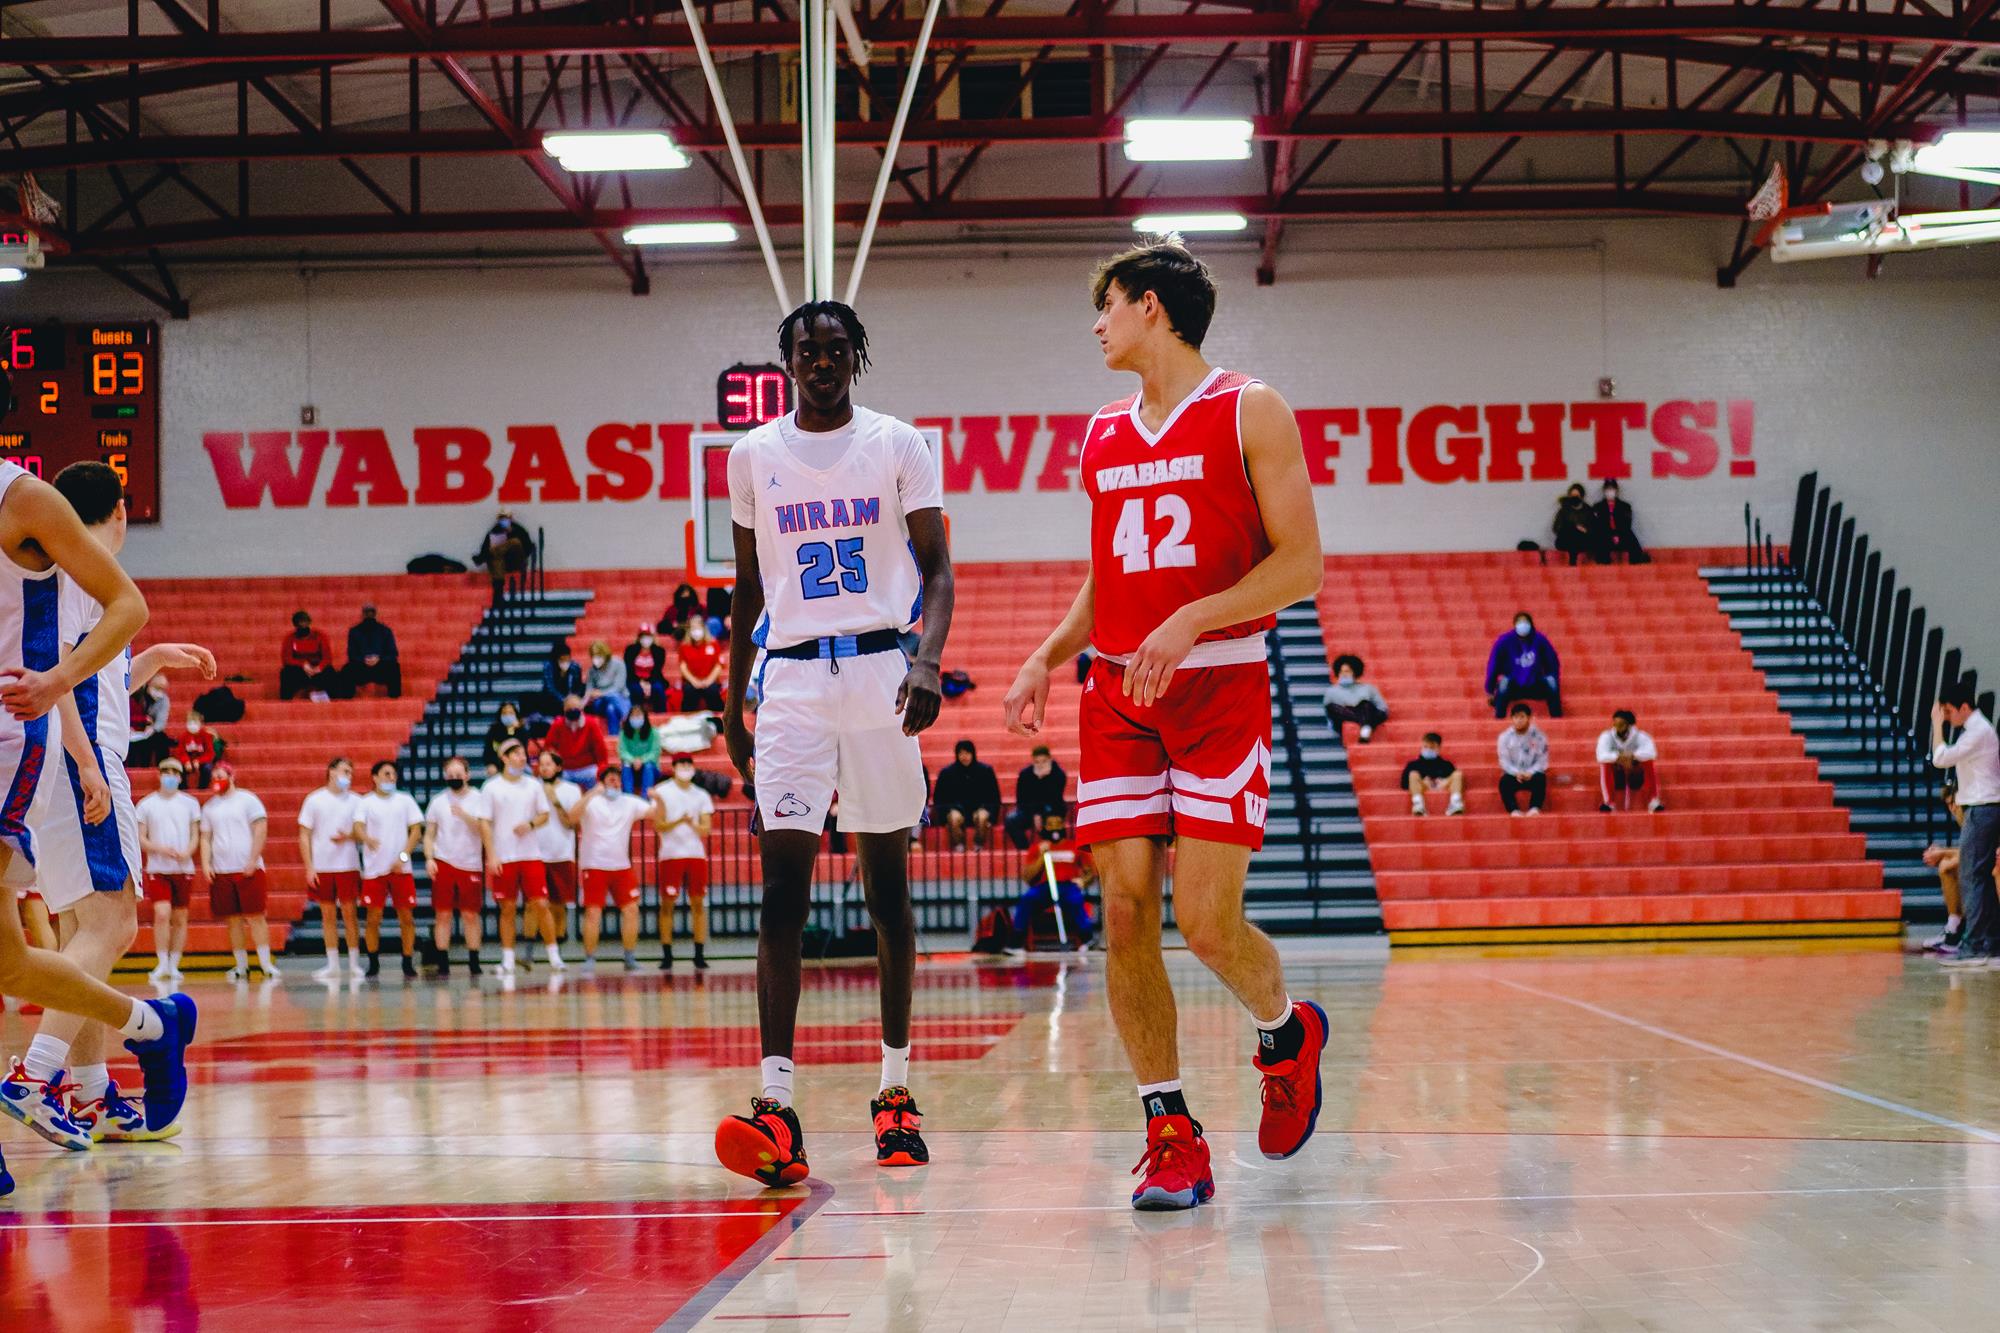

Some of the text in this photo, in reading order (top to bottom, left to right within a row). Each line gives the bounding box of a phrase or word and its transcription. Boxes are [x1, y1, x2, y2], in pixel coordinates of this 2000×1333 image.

[93, 352, 143, 395] 83
[40, 381, 59, 414] 2
[726, 373, 784, 423] 30
[0, 434, 24, 449] ayer
[1294, 400, 1756, 485] FIGHTS!
[1096, 455, 1204, 493] WABASH
[776, 497, 880, 534] HIRAM
[1113, 494, 1196, 574] 42
[797, 537, 869, 600] 25
